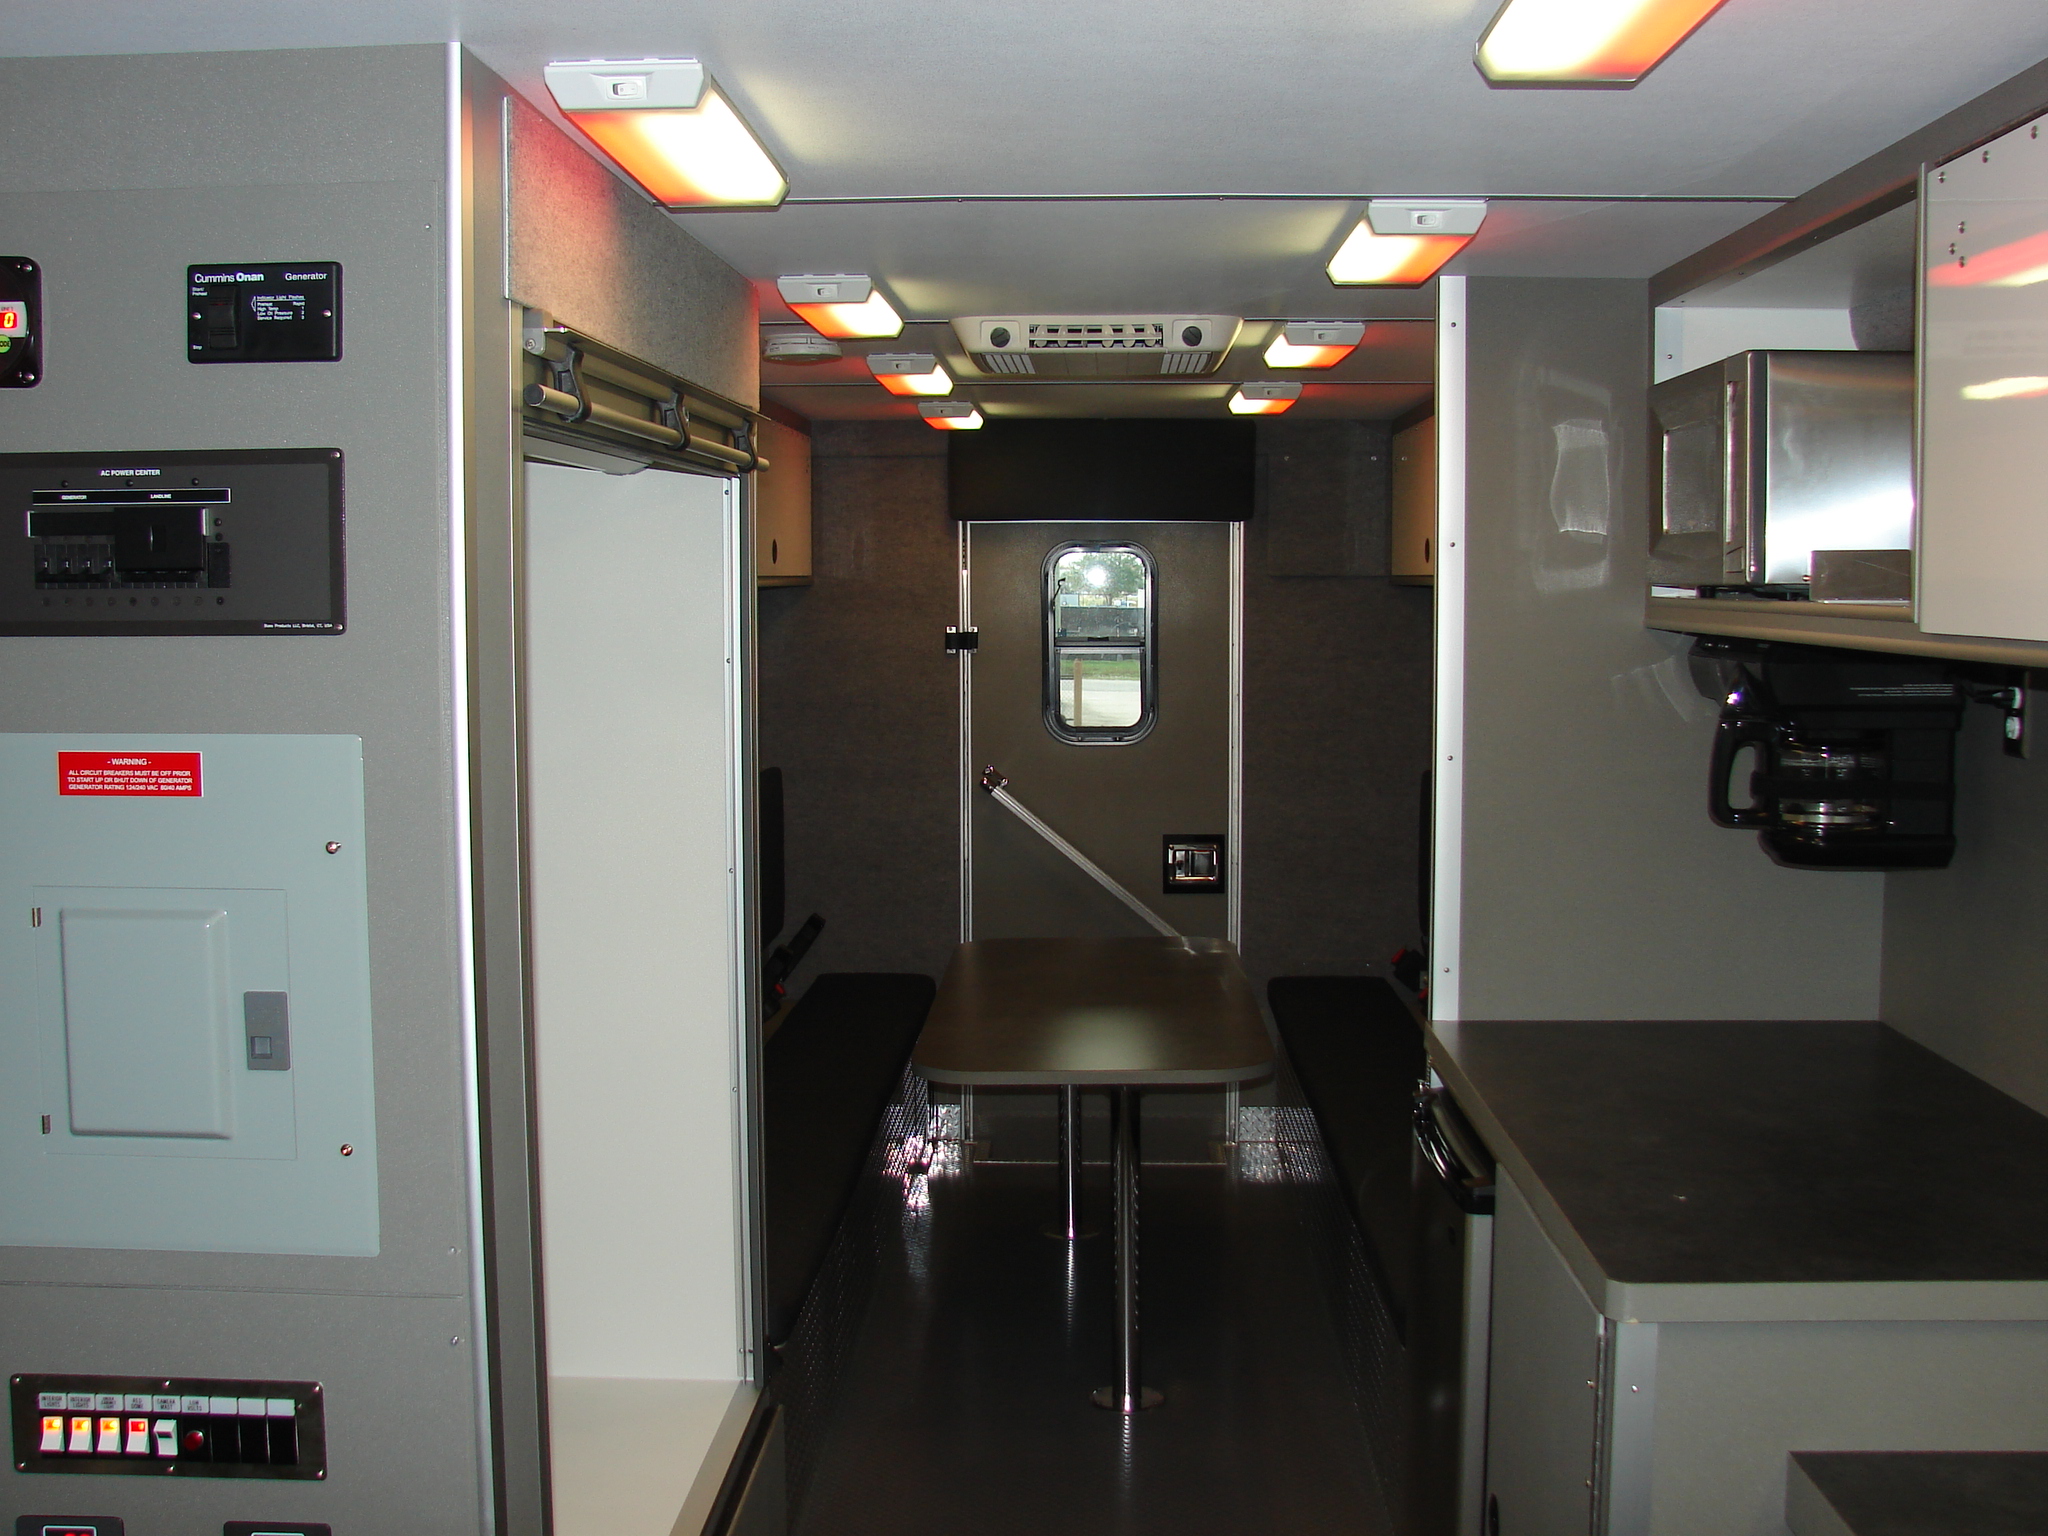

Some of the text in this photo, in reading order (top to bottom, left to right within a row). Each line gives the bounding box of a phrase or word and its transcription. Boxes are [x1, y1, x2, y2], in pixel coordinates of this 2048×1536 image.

[194, 272, 327, 283] Cummins Onan Generator
[4, 312, 14, 328] 0
